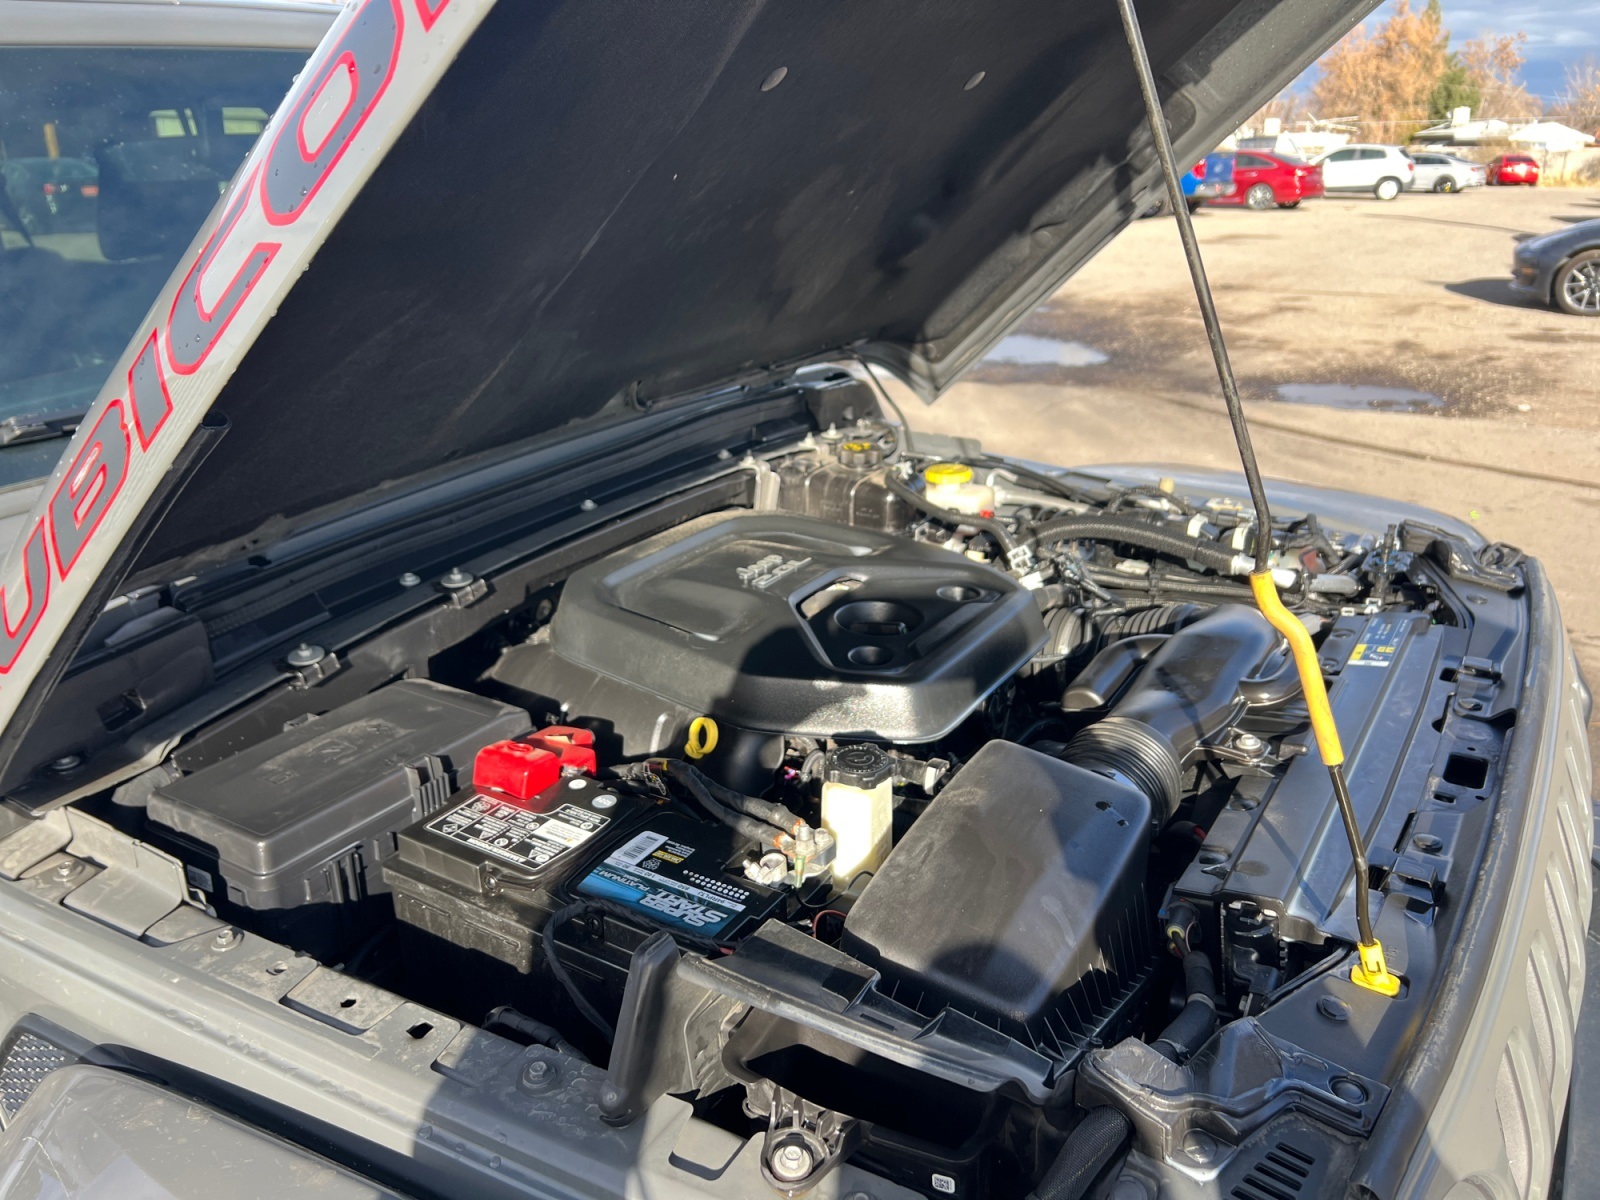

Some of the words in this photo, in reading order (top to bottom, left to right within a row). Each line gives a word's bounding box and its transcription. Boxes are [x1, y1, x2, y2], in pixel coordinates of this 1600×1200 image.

[0, 0, 451, 675] UBICO
[599, 869, 649, 891] PLATINUM
[639, 894, 707, 927] SUPER
[646, 890, 727, 923] START
